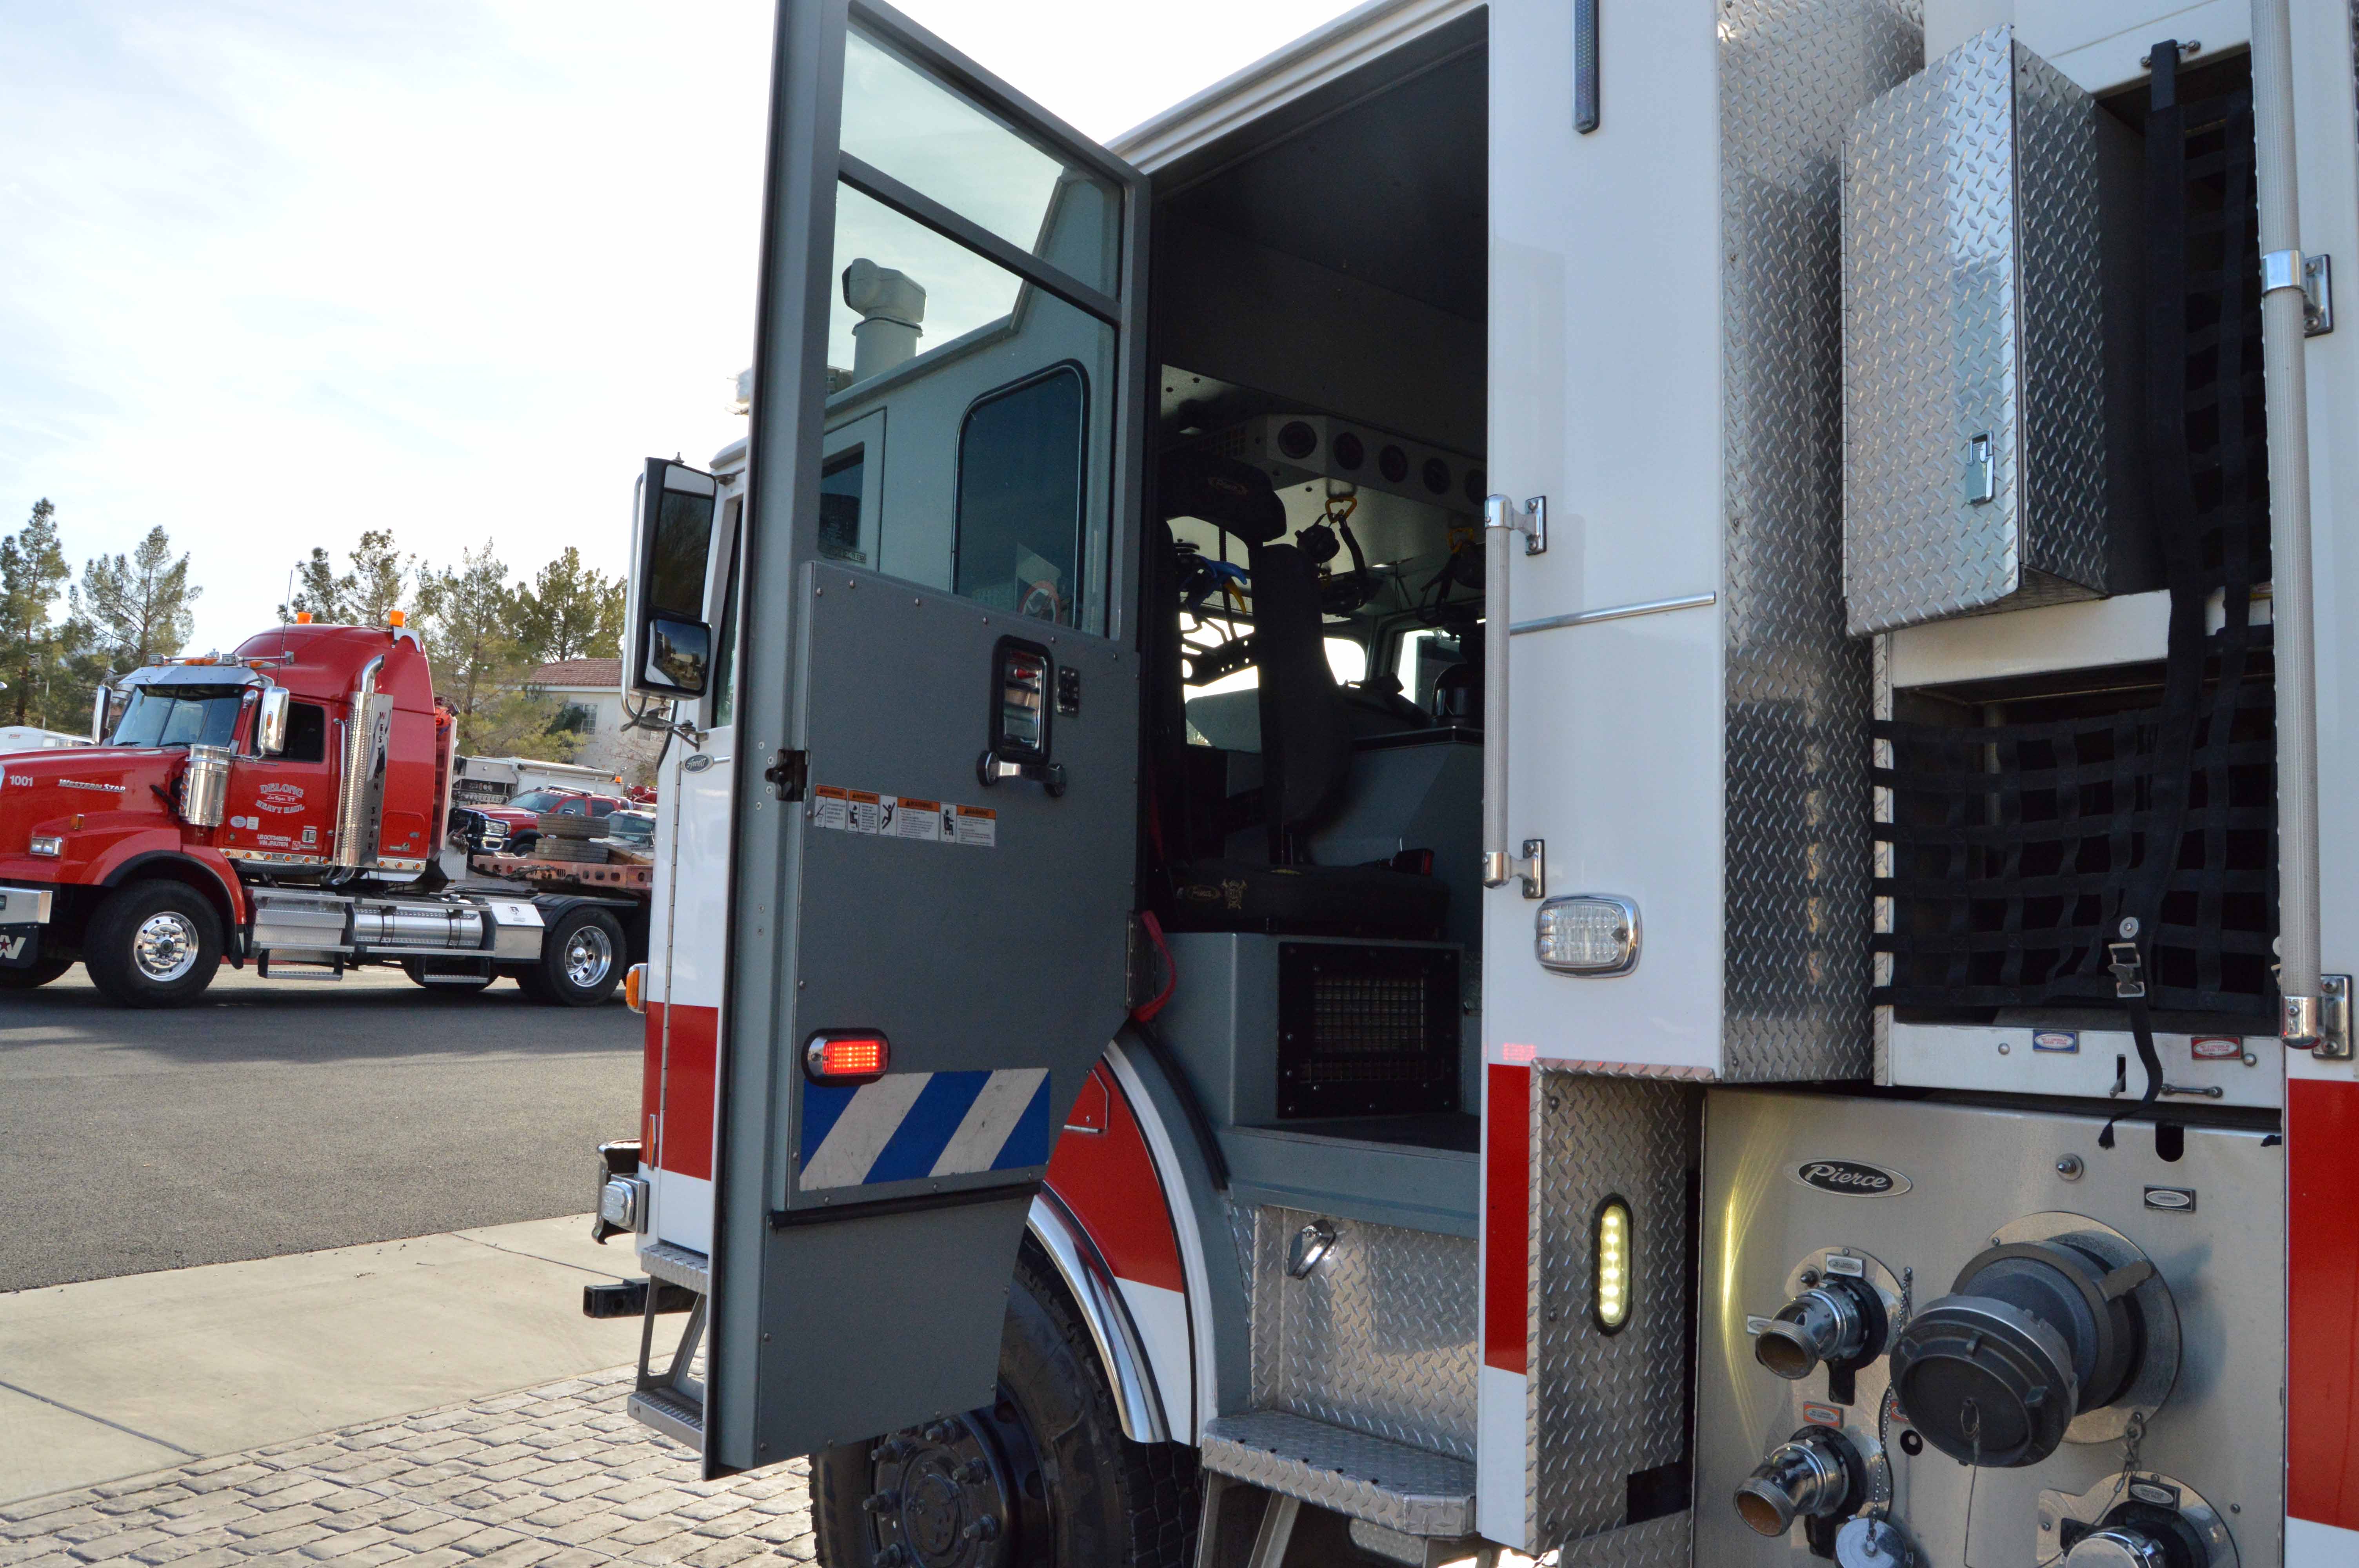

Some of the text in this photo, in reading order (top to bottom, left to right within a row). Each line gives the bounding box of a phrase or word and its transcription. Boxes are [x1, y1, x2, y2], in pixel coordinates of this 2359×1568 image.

[10, 775, 33, 786] 1001
[59, 779, 102, 789] WESTERN
[259, 783, 304, 798] DELONG
[255, 799, 305, 813] HEAVY HAUL
[1805, 1164, 1887, 1187] Pierce
